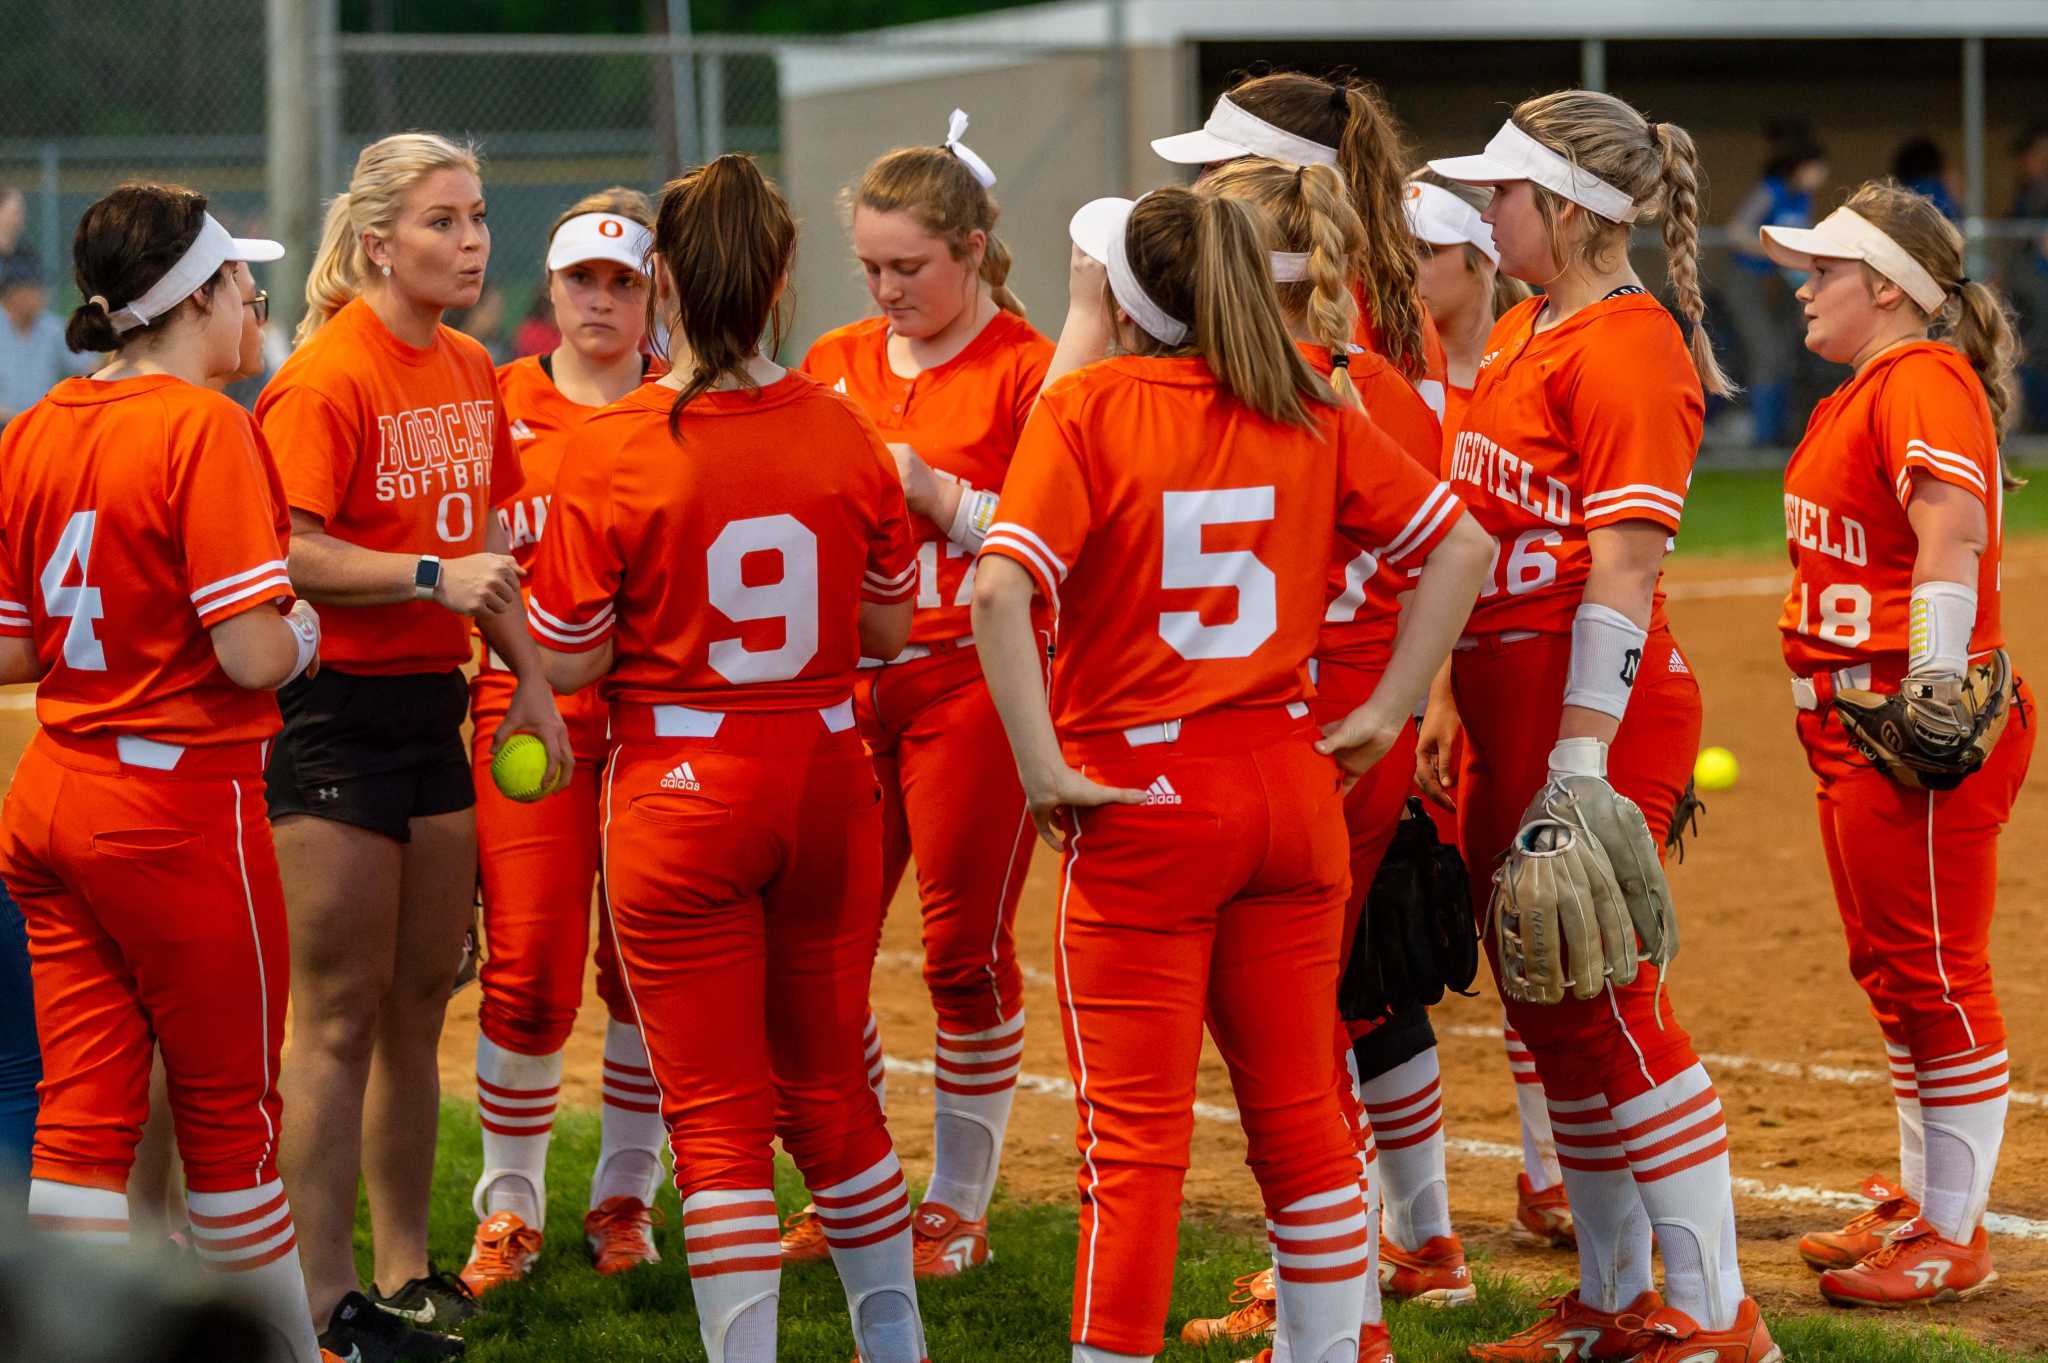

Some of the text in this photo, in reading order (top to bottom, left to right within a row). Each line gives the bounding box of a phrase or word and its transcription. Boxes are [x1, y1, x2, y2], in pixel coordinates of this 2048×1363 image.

[598, 219, 624, 238] O
[40, 510, 107, 671] 4
[707, 514, 818, 683] 9
[1158, 486, 1276, 660] 5
[1797, 582, 1872, 649] 18
[660, 777, 701, 792] adidas
[1144, 793, 1182, 806] didas
